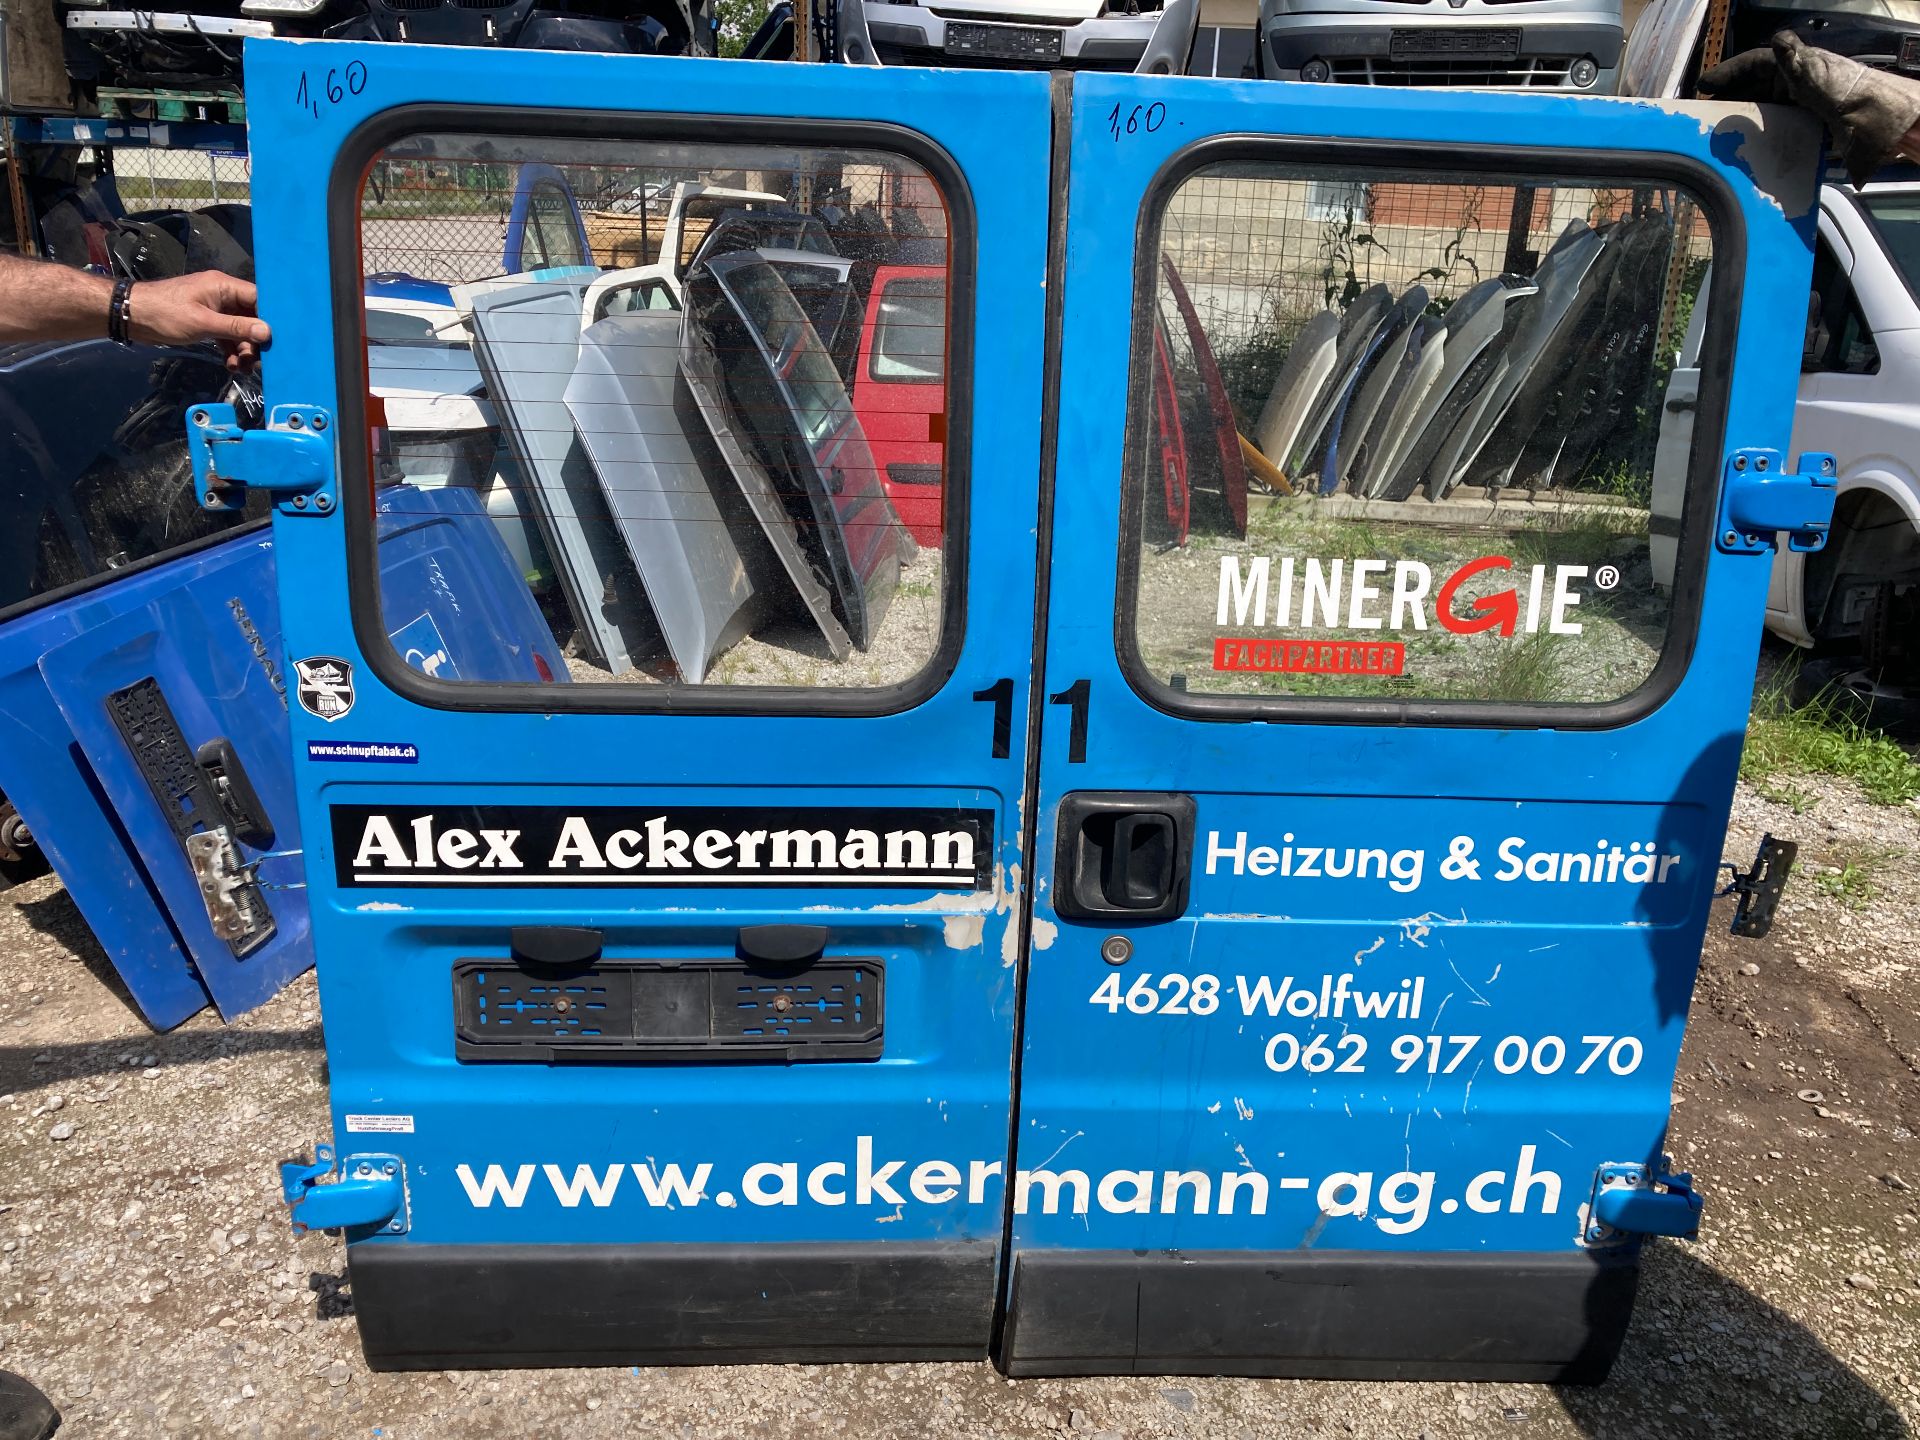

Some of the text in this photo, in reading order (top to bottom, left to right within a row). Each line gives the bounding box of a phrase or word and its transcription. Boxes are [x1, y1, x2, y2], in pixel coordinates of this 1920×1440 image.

[297, 60, 367, 119] 1,60
[1223, 643, 1397, 671] FACHPARTNER
[318, 699, 337, 711] RUN
[309, 744, 416, 759] www.schnupftabak.ch
[352, 814, 976, 870] Alex Ackermann
[1205, 830, 1681, 893] Heizung & Sanitär
[1089, 973, 1426, 1020] 4628 Wolfwil
[1263, 1032, 1645, 1077] 062 917 00 70
